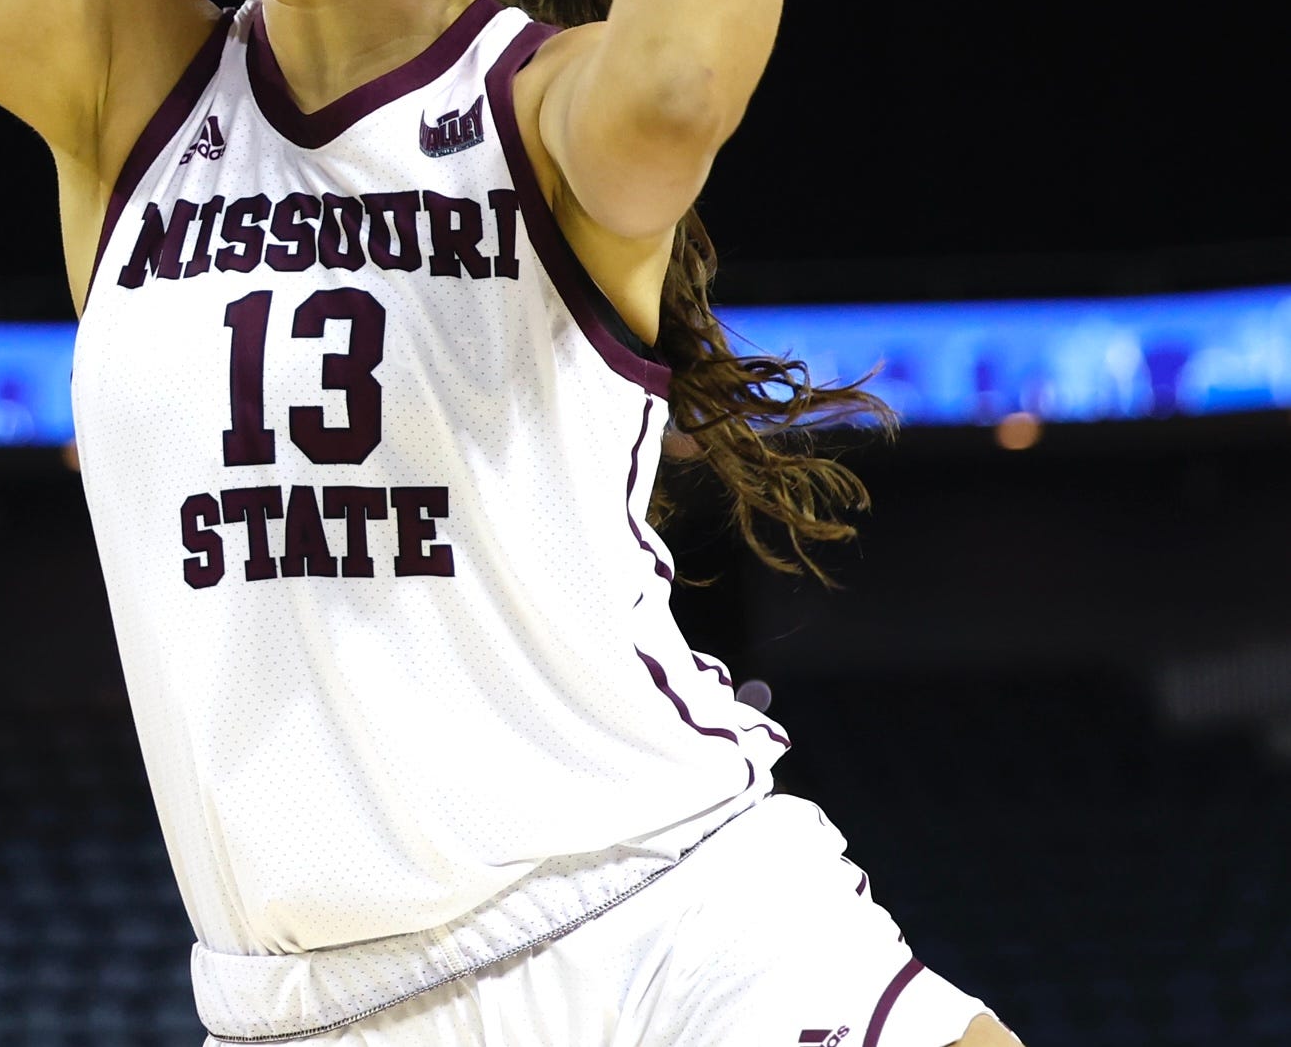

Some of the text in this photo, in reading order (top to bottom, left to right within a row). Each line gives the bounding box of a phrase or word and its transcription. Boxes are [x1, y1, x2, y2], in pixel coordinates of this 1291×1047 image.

[117, 189, 520, 289] MISSOURI
[222, 287, 386, 467] 13
[180, 485, 455, 590] STATE
